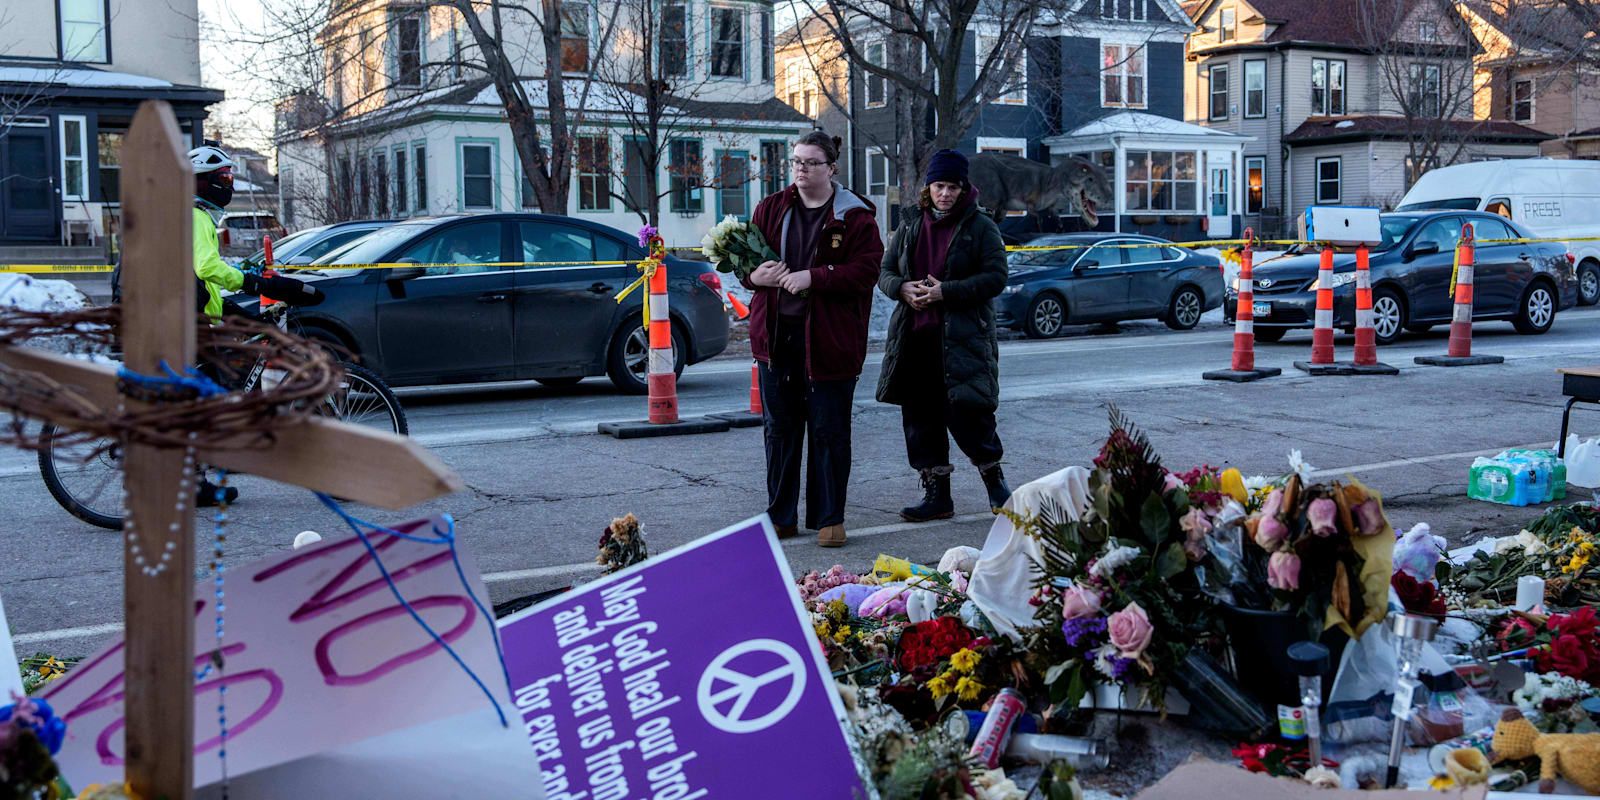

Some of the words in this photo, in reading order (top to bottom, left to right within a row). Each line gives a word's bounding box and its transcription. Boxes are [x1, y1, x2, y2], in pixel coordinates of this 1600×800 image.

[1523, 201, 1562, 218] PRESS
[252, 518, 478, 686] NO
[595, 575, 647, 627] May
[552, 605, 605, 648] and
[612, 621, 667, 671] God
[514, 673, 562, 714] for
[561, 642, 614, 717] deliver
[622, 660, 682, 720] heal
[524, 714, 562, 762] ever
[577, 714, 615, 749] us
[635, 716, 678, 761] our
[585, 740, 635, 800] from
